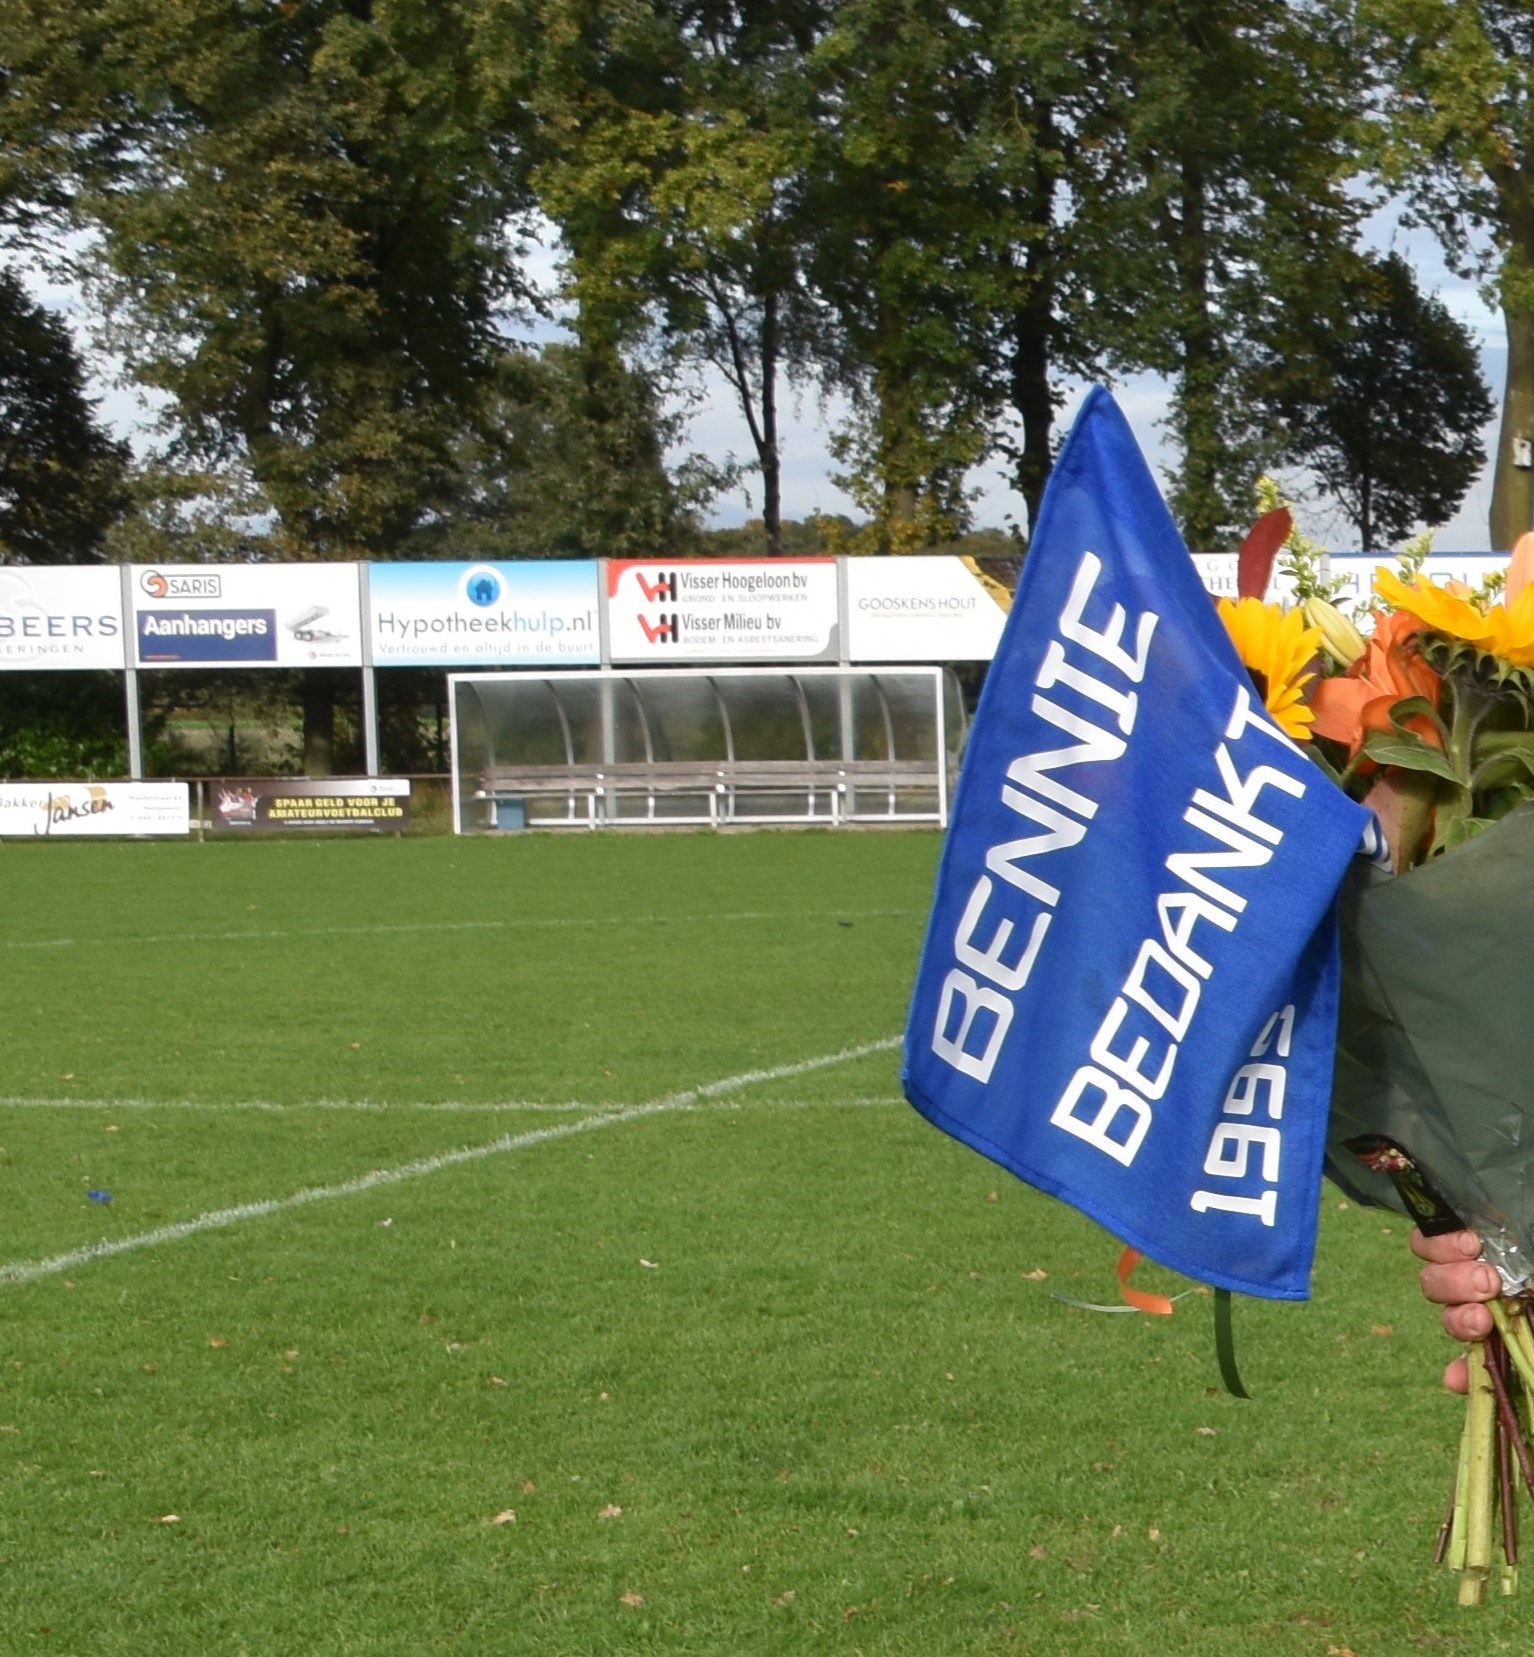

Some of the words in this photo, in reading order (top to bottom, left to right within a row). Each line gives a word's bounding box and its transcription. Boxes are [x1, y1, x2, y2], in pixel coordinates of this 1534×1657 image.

[170, 579, 218, 594] SARIS
[680, 572, 720, 589] Visser
[722, 571, 791, 592] Hoogeloon
[792, 571, 808, 588] bv
[858, 597, 937, 610] GOOSKENS
[938, 597, 977, 610] HOUT
[144, 613, 268, 640] Aanhangers
[378, 610, 593, 638] Hypotheekhulp.nl
[682, 614, 721, 630] Visser
[723, 612, 762, 630] Milieu
[766, 612, 782, 629] bv
[379, 643, 448, 654] Vertrouwd
[454, 644, 470, 653] en
[476, 641, 511, 656] altijd
[517, 643, 530, 652] in
[535, 640, 551, 652] de
[558, 640, 594, 652] buurt
[275, 798, 313, 808] SPAAR
[315, 798, 344, 807] GELD
[349, 798, 378, 807] VOOR
[381, 797, 396, 807] JE
[34, 791, 115, 835] Jansen
[268, 806, 403, 819] AMATEURVOETBALCLUB
[931, 550, 1158, 1085] BENNIE
[1050, 683, 1306, 1168] BEDANKT
